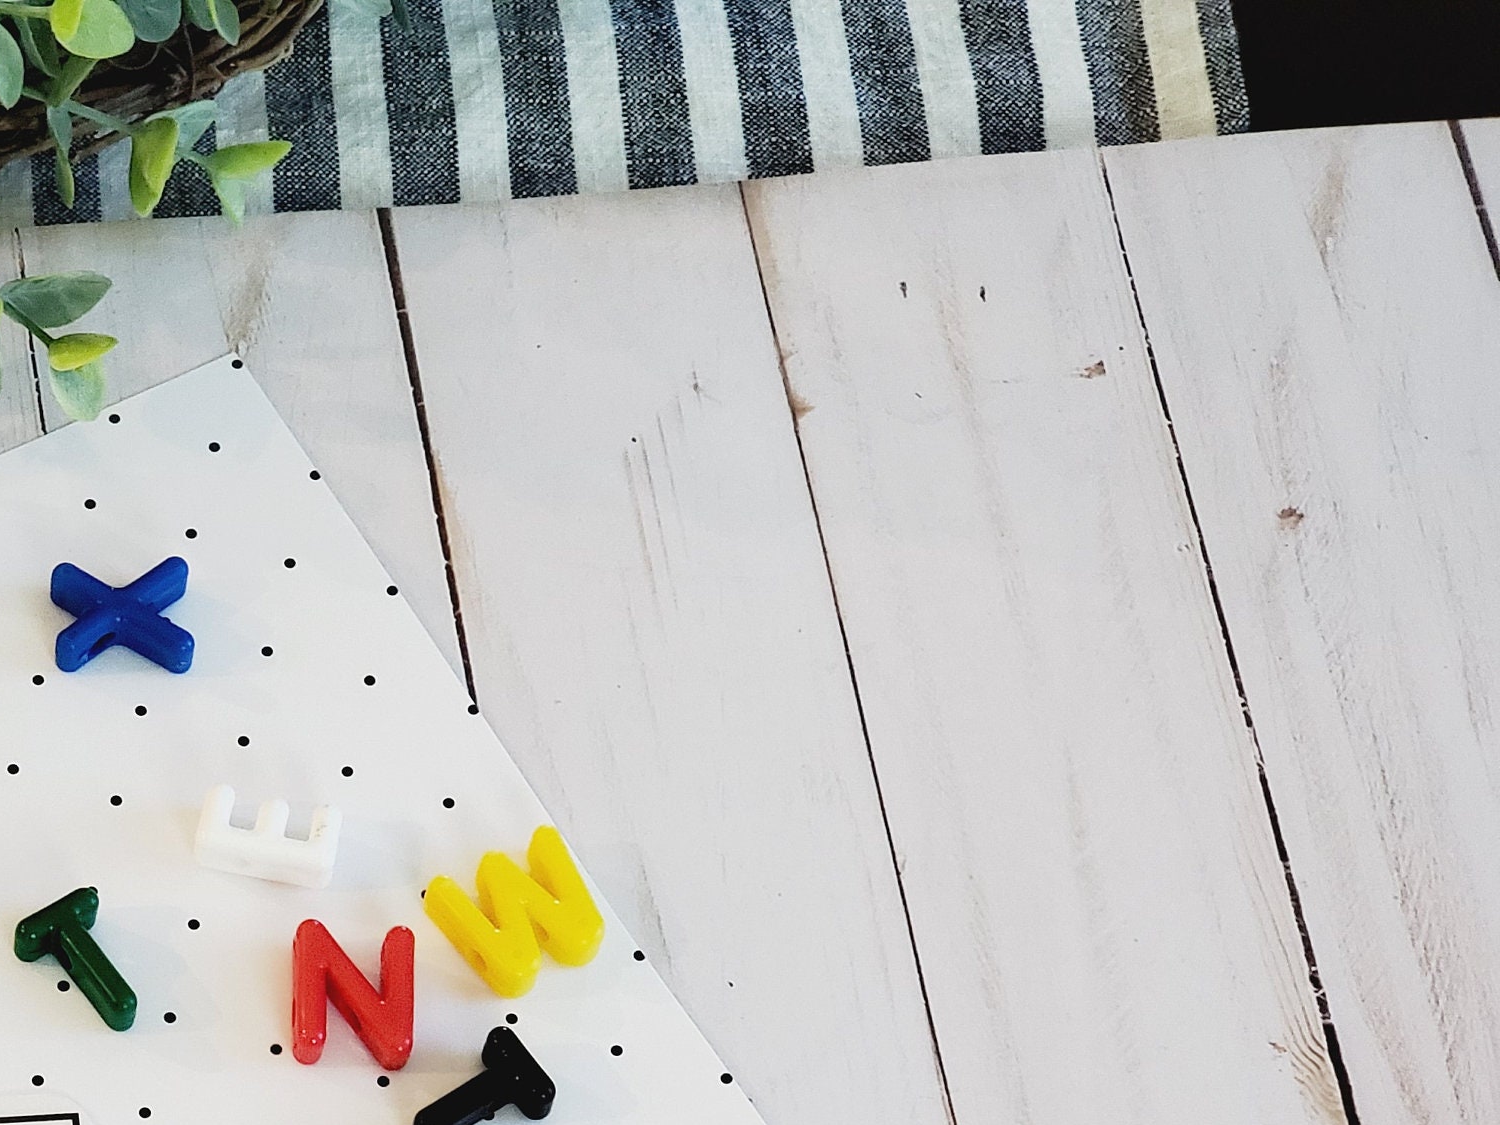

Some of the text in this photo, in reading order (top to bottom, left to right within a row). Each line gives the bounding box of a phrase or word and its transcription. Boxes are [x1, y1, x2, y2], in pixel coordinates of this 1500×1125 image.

[50, 556, 195, 674] X
[196, 783, 342, 889] E
[14, 887, 137, 1032] T
[423, 825, 605, 998] W
[293, 919, 415, 1071] N
